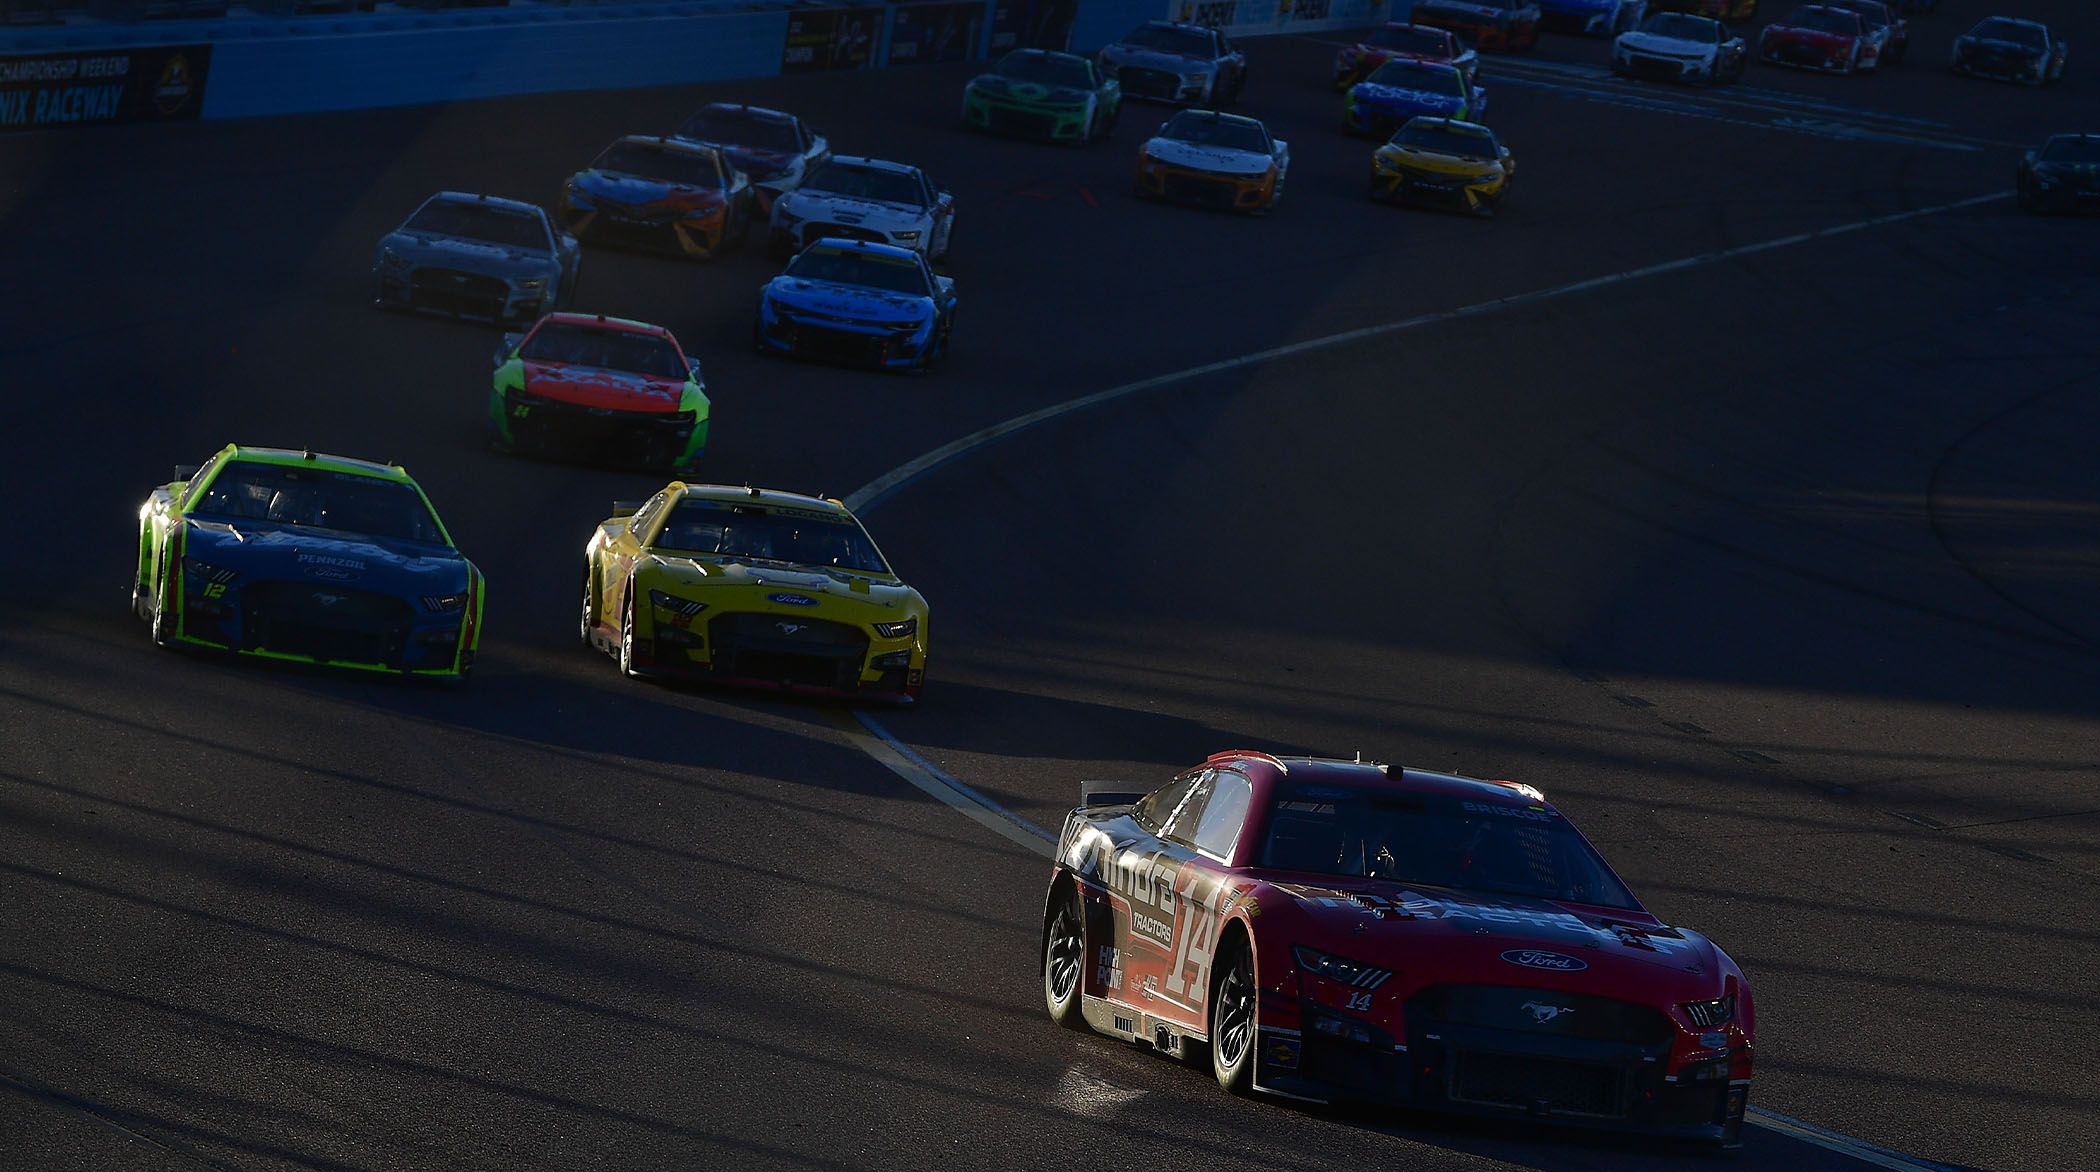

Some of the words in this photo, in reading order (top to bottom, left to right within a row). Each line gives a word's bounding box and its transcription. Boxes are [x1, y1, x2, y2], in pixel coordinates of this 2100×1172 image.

[33, 85, 124, 123] RACEWAY
[297, 554, 368, 571] PENNZOIL
[315, 567, 351, 579] Ford
[202, 582, 227, 599] 12
[775, 593, 811, 606] Ford
[1462, 801, 1552, 823] BRISCOE
[1133, 911, 1172, 947] TRACTORS
[1166, 878, 1218, 1003] 14
[1516, 952, 1574, 970] Ford
[1345, 991, 1374, 1013] 14
